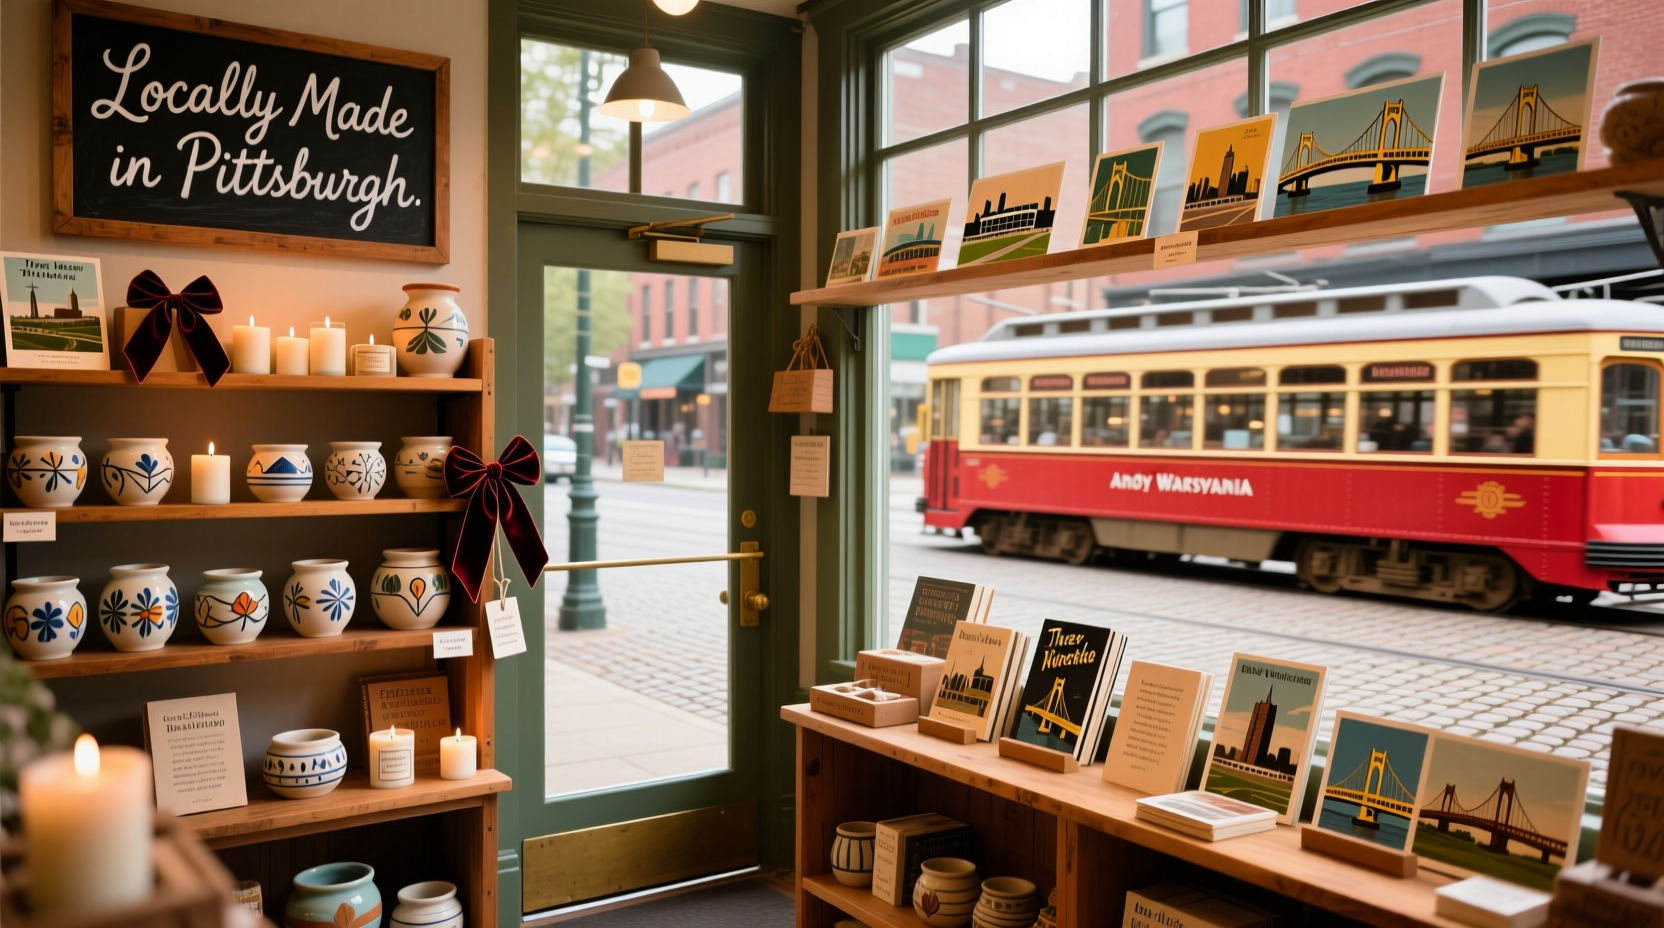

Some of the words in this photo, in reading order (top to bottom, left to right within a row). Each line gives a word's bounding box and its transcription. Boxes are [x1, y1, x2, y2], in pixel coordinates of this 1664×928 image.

[91, 43, 283, 145] Locally
[288, 73, 414, 140] Made
[110, 145, 161, 188] in
[176, 131, 421, 232] Pittsburgh.
